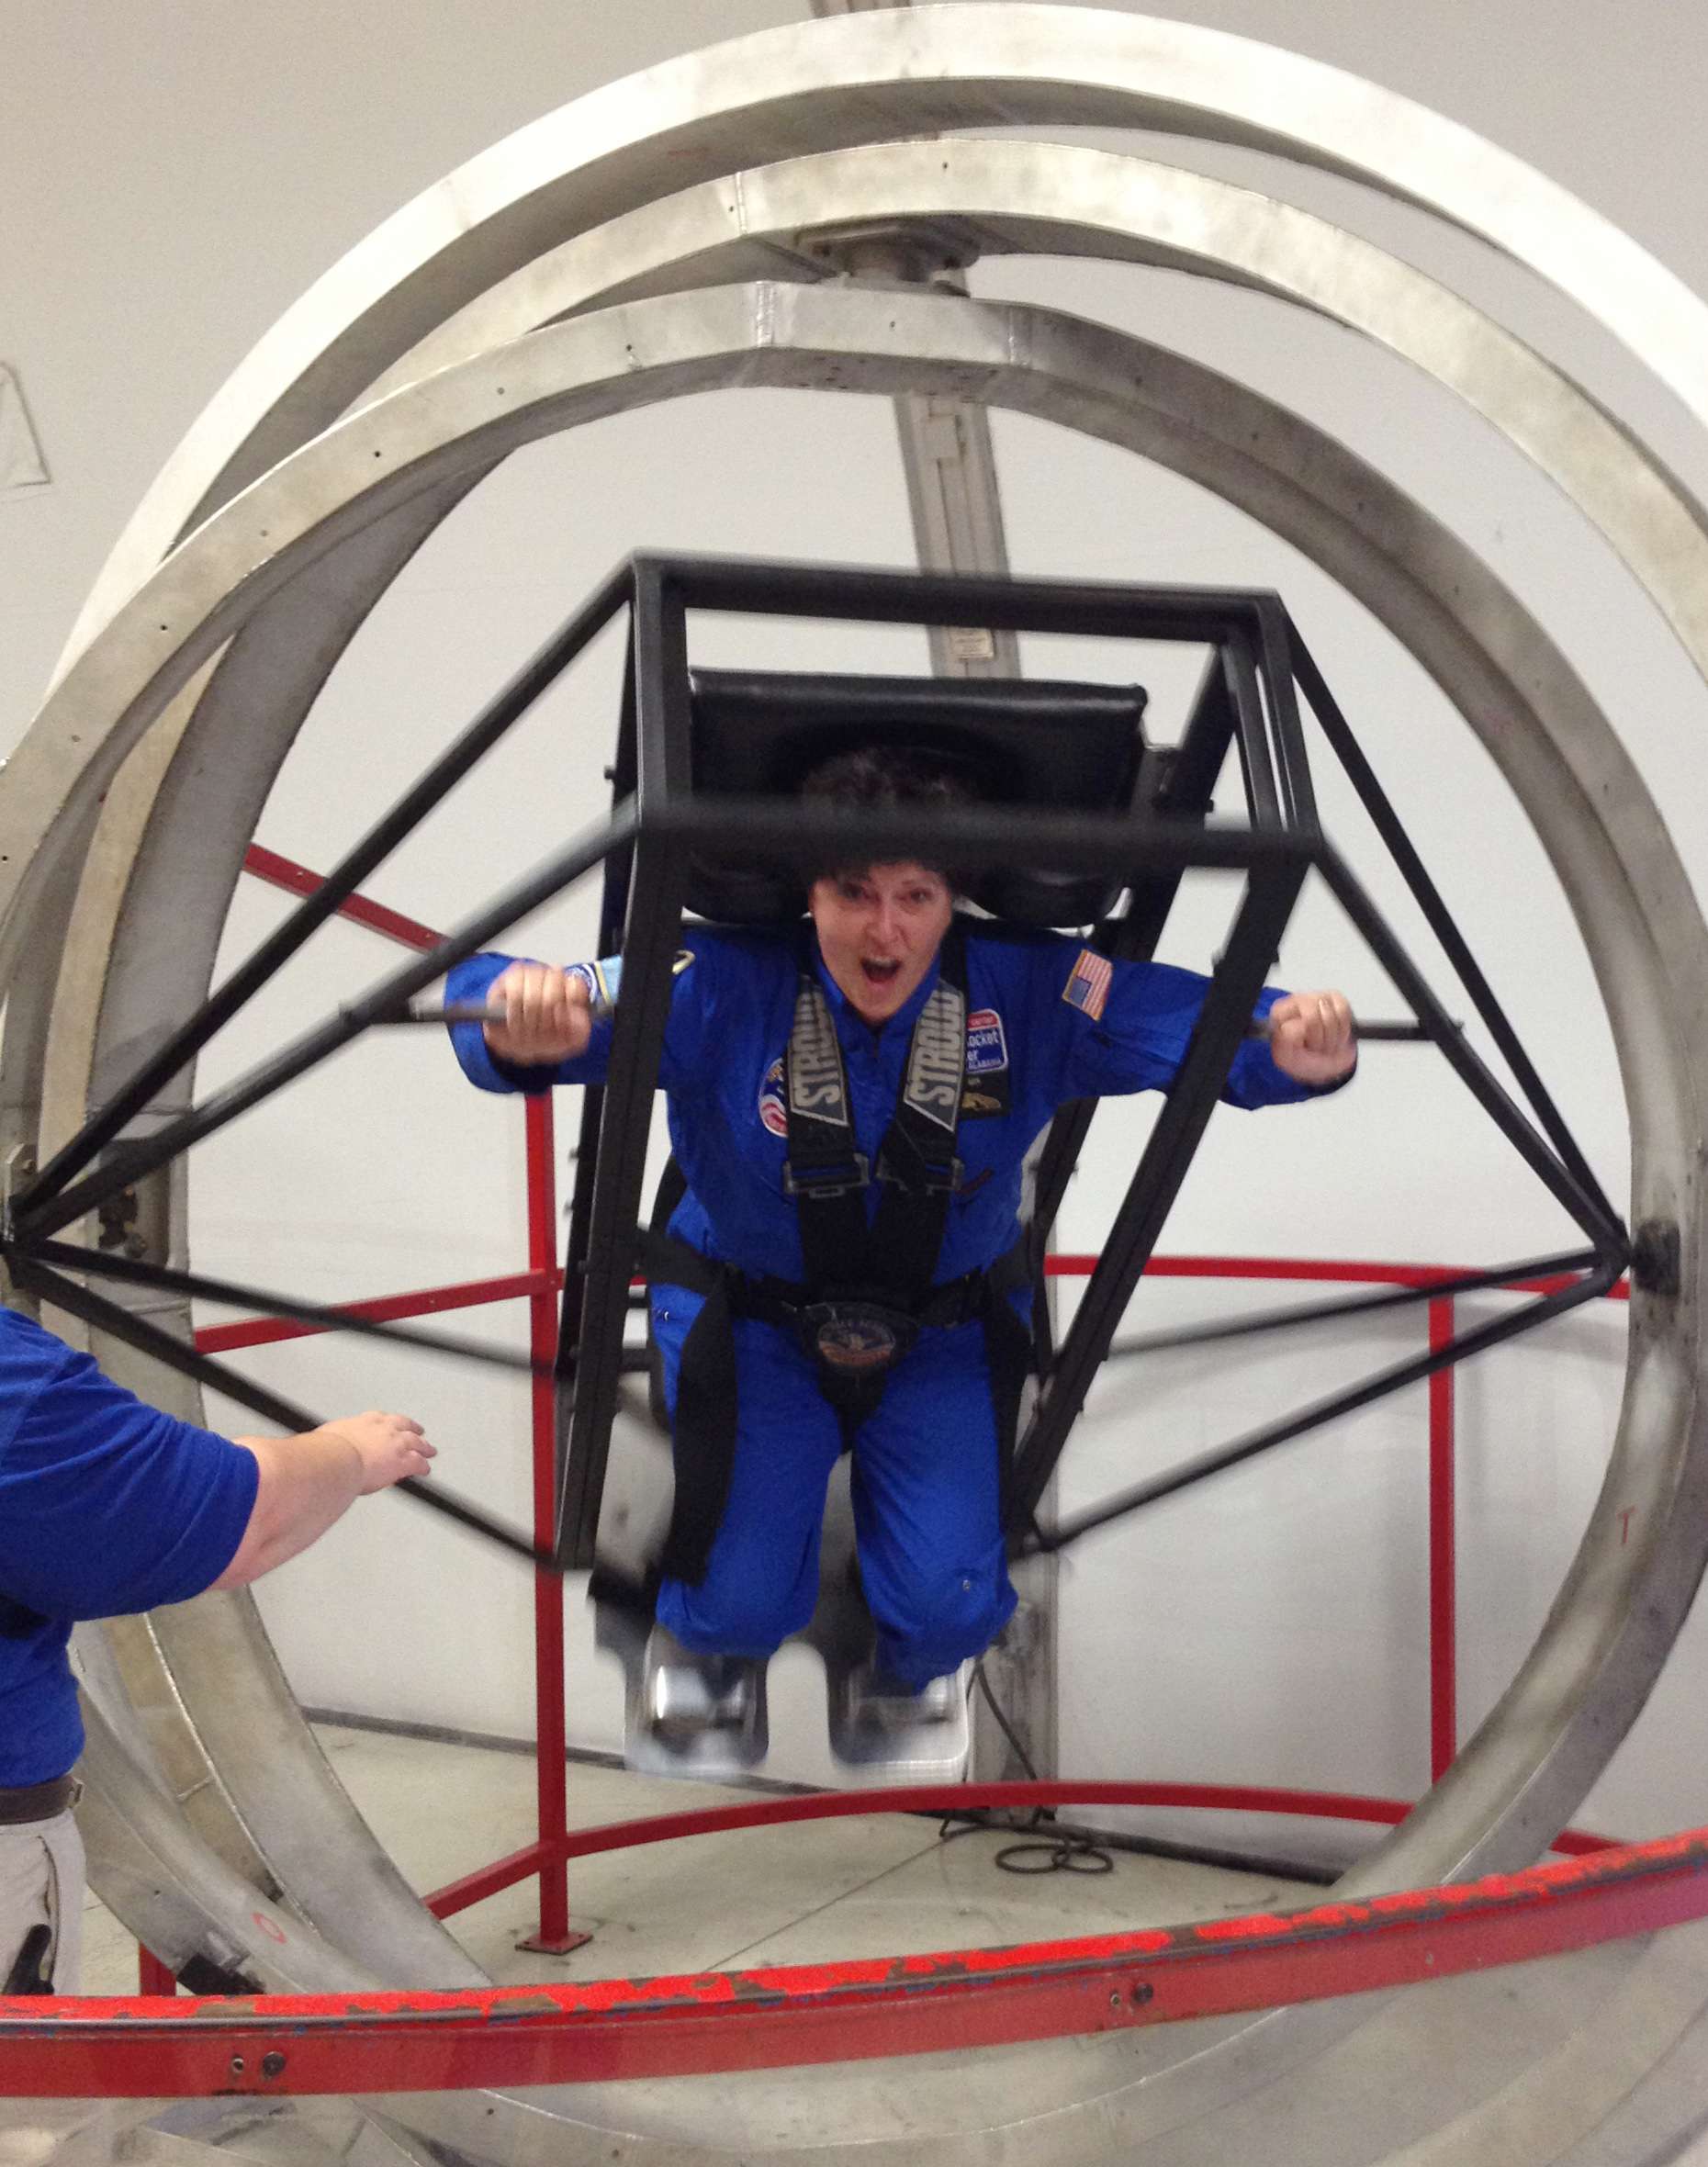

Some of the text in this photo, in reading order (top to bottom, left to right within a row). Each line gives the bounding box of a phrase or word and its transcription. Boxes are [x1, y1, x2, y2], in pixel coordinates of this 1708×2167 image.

[792, 992, 841, 1107] STROUD
[908, 990, 961, 1106] STROUD
[967, 1028, 1000, 1048] ocket
